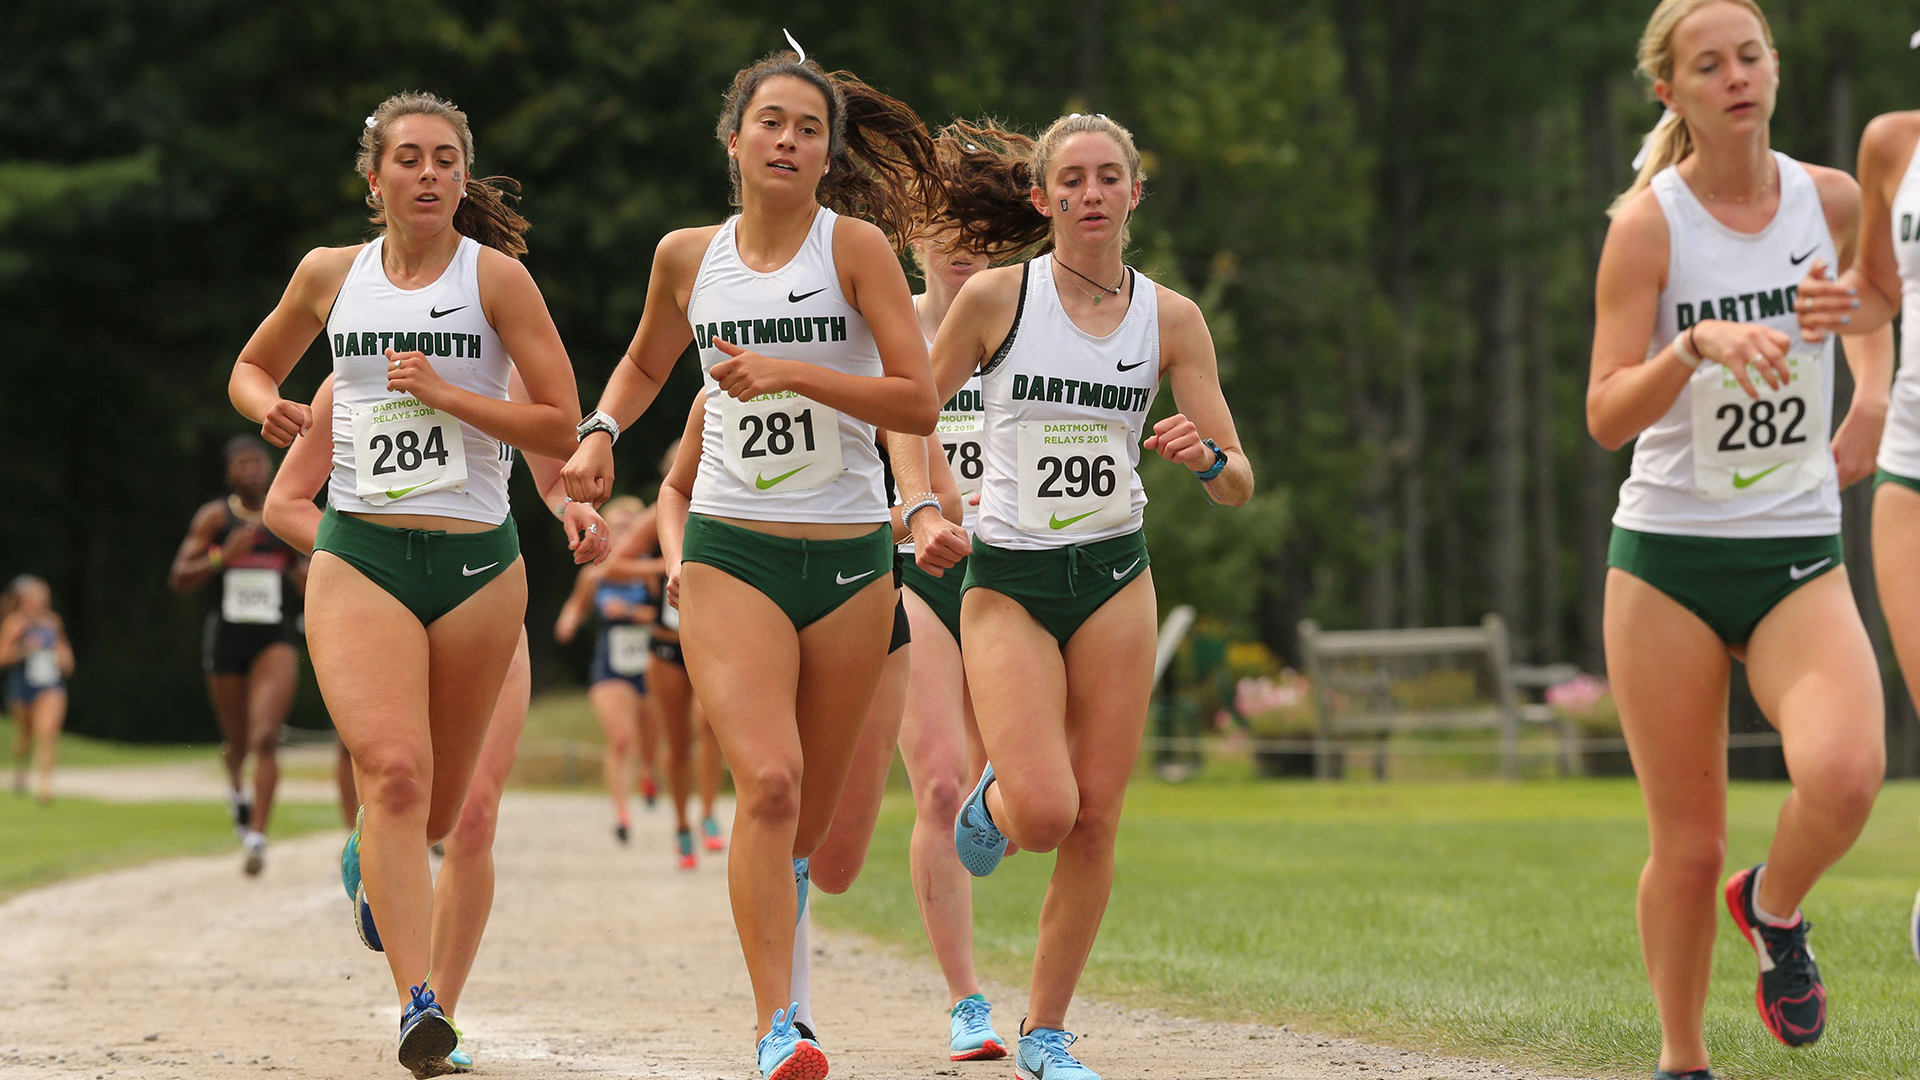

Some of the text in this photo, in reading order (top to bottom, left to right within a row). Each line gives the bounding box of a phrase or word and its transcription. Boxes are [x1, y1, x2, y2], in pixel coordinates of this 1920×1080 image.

[1677, 285, 1799, 331] DARTMO
[333, 332, 481, 359] DARTMOUTH
[694, 316, 847, 350] DARTMOUTH
[373, 400, 423, 413] DARTMOU
[749, 391, 783, 403] ELAYS
[1012, 374, 1151, 412] DARTMOUTH
[373, 408, 435, 424] RELAYS 2018
[1044, 424, 1108, 433] DARTMOUTH
[1716, 396, 1807, 452] 282
[369, 426, 449, 476] 284
[739, 409, 816, 459] 281
[1044, 436, 1108, 445] RELAYS 2018
[1037, 455, 1116, 497] 296
